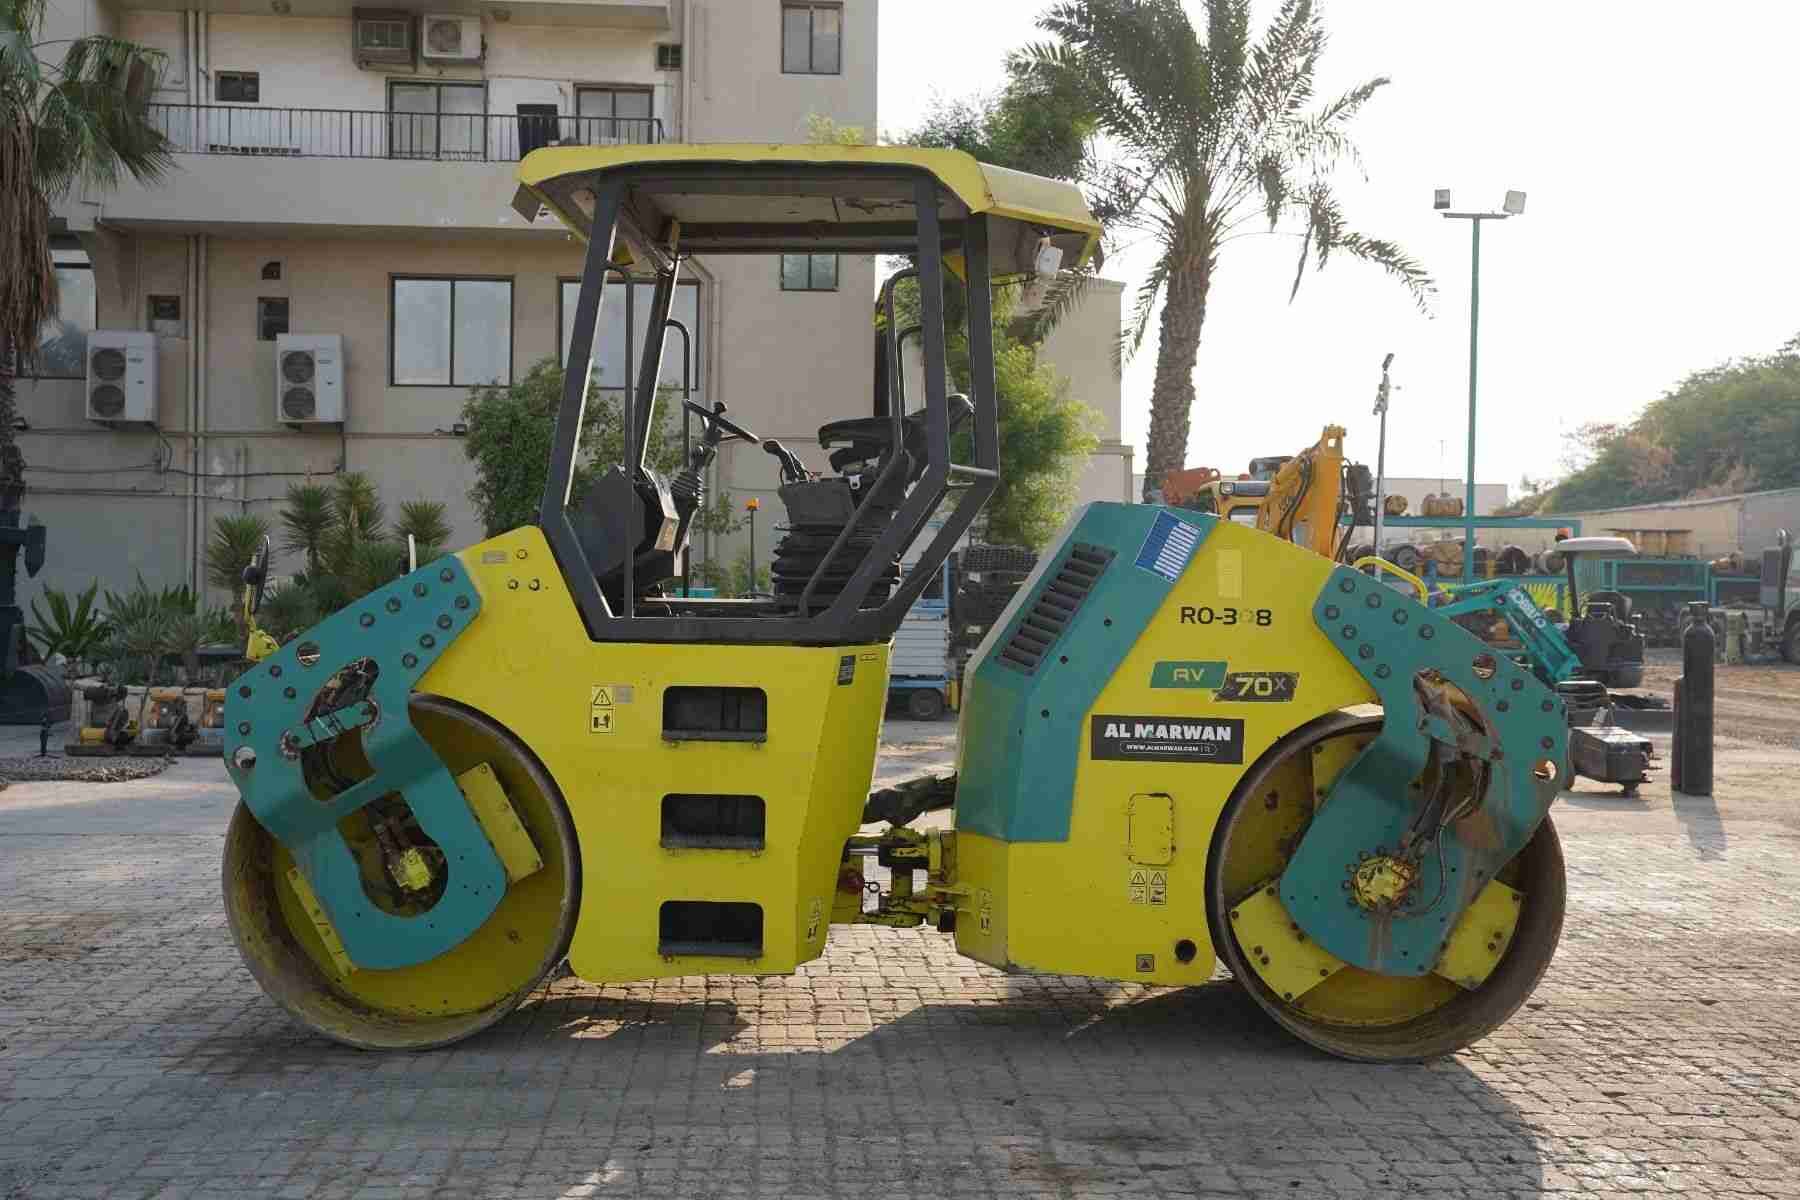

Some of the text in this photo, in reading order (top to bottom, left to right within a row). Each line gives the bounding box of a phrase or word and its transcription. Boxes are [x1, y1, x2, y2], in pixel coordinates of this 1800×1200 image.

[1180, 606, 1272, 626] RO-38
[1104, 723, 1231, 741] AL MARWAN
